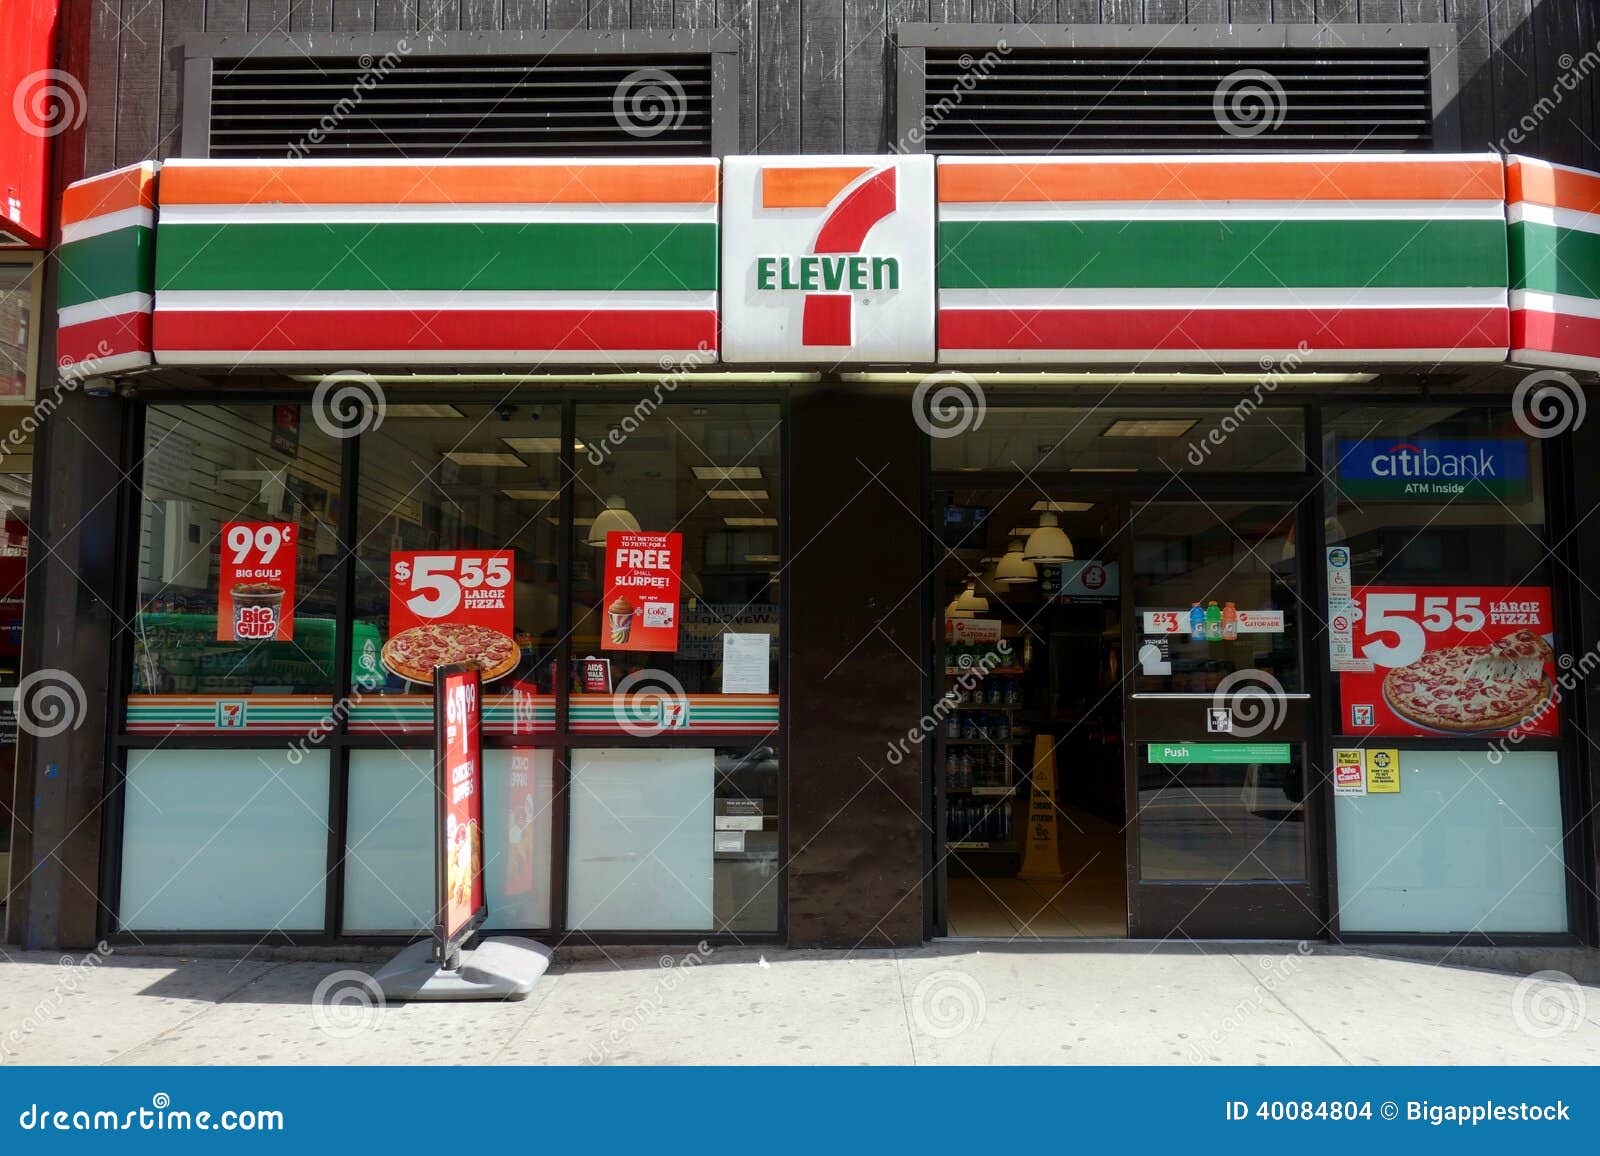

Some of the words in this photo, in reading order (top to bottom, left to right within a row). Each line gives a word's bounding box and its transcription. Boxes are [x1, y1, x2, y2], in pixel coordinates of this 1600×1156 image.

[1371, 444, 1496, 477] citibank
[1404, 484, 1429, 494] ATM
[1432, 483, 1465, 494] Inside
[615, 548, 671, 569] FREE
[235, 569, 253, 578] BIG
[254, 569, 282, 578] GULP
[615, 575, 670, 588] SLURPEE!
[464, 589, 505, 599] LARGE
[464, 599, 505, 609] PIZZA
[1489, 601, 1540, 613] LARGE
[1490, 613, 1541, 625] PIZZA
[236, 622, 276, 637] GULP
[587, 663, 603, 672] AIDS
[1164, 748, 1189, 757] Push
